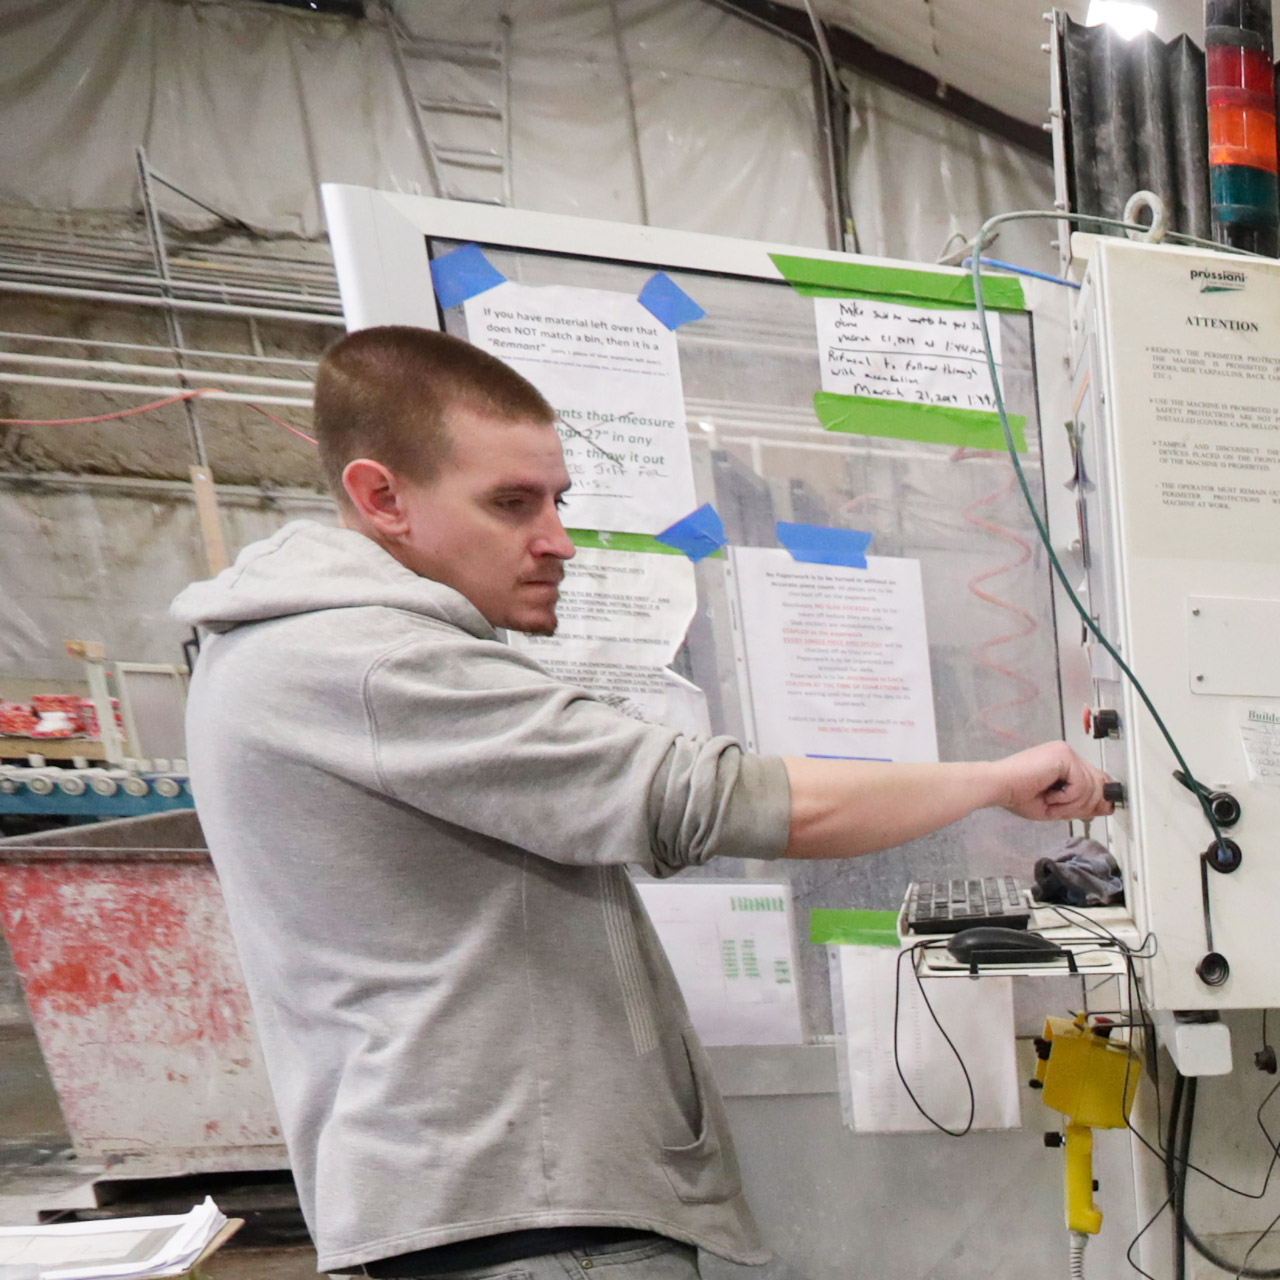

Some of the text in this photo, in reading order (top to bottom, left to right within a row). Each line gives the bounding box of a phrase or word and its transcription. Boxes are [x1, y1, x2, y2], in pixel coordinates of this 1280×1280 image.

[1190, 269, 1245, 282] prussiani
[484, 308, 658, 336] If you have material left over that
[1185, 316, 1259, 332] ATTENTION
[487, 324, 511, 334] does
[515, 326, 536, 336] NOT
[541, 330, 572, 341] match
[584, 334, 604, 345] bin,
[606, 337, 629, 348] then
[633, 341, 640, 349] it
[643, 342, 650, 350] is
[1151, 346, 1181, 355] REMOVE
[1186, 349, 1199, 357] THE
[1203, 351, 1243, 361] PERIMETER
[1153, 354, 1165, 362] THE
[1172, 356, 1205, 366] MACHINE
[1226, 361, 1267, 372] PROHIBITED
[1246, 372, 1265, 380] BACK
[854, 383, 904, 398] March
[1155, 397, 1167, 405] USE
[1186, 400, 1218, 409] MACHINE
[1229, 404, 1271, 413] PROHIBITED
[556, 409, 675, 428] ants that measure
[1156, 406, 1182, 414] SAFETY
[1186, 408, 1235, 419] PROTECTIONS
[1257, 414, 1270, 422] NOT
[1156, 414, 1195, 424] INSTALLED
[612, 432, 624, 442] in
[628, 435, 652, 446] any
[1159, 440, 1186, 448] TAMPER
[1216, 444, 1259, 454] DISCONNECT
[1267, 448, 1280, 456] THE
[1159, 448, 1188, 457] DEVICES
[1192, 451, 1219, 459] PLACED
[1238, 454, 1250, 462] THE
[587, 448, 626, 462] throw
[630, 452, 638, 462] it
[642, 455, 665, 464] out
[1170, 457, 1183, 465] THE
[1186, 459, 1218, 467] MACHINE
[1162, 490, 1200, 499] PERIMETER
[1213, 494, 1259, 503] PROTECTIONS
[1177, 483, 1214, 492] OPERATOR
[1239, 487, 1266, 496] REMAIN
[1163, 499, 1195, 507] MACHINE
